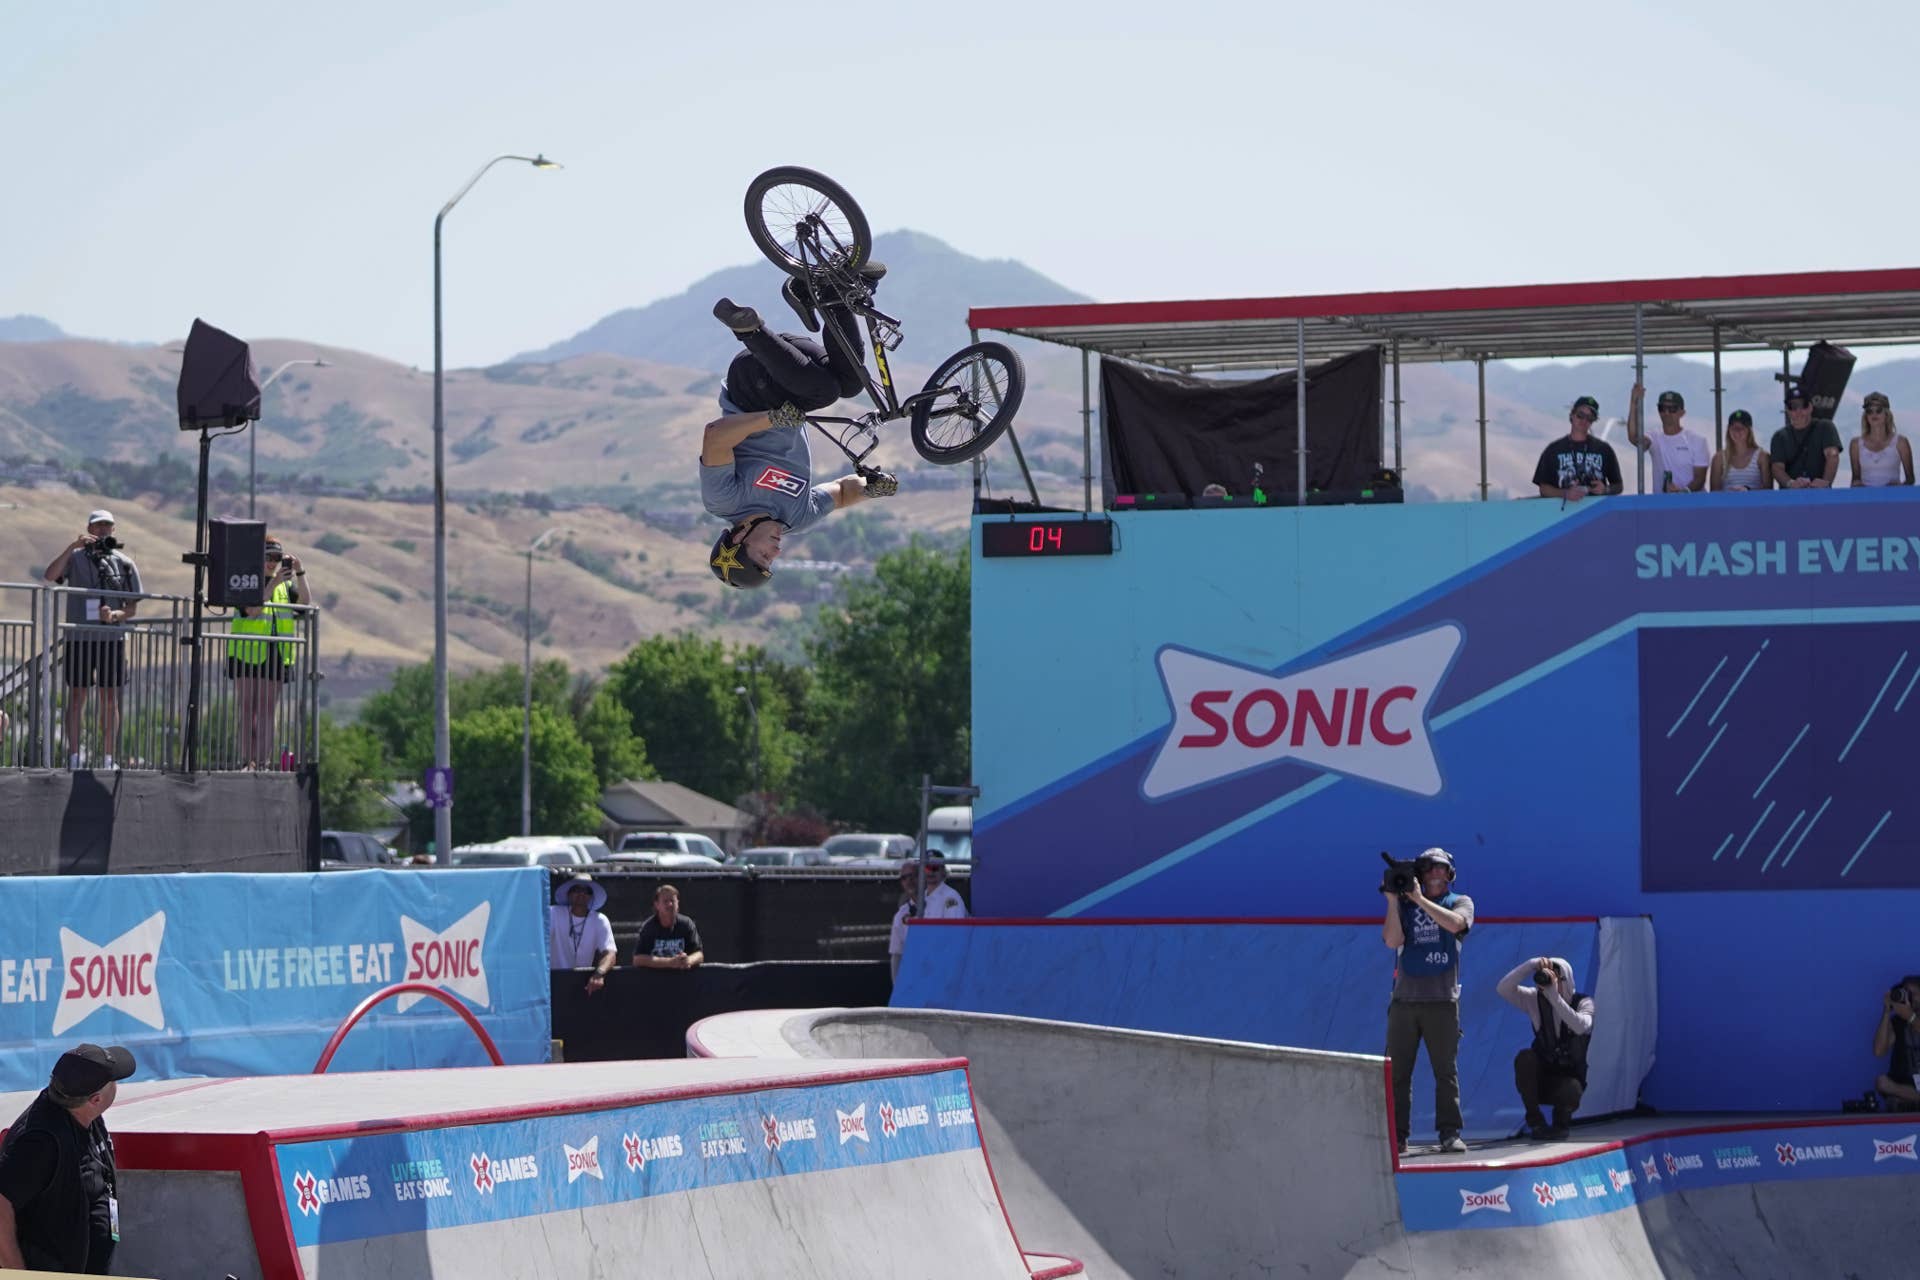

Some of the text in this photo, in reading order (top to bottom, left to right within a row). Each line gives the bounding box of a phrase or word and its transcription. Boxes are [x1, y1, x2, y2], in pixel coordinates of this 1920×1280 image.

[1029, 527, 1063, 551] 04
[1634, 540, 1787, 579] SMASH
[230, 574, 259, 590] OSA
[1178, 685, 1418, 749] SONIC
[223, 938, 480, 991] LIVE FREE EAT SONIC
[1425, 951, 1449, 965] 409
[1, 953, 153, 1003] EAT SONIC
[841, 1117, 865, 1133] SONIC
[894, 1104, 929, 1129] GAMES
[937, 1107, 975, 1128] EAT SONIC
[698, 1122, 718, 1140] LIVE
[779, 1118, 817, 1142] GAMES
[641, 1134, 683, 1161] GAMES
[701, 1136, 747, 1159] EAT SONIC
[1795, 1144, 1844, 1161] GAMES
[1877, 1143, 1913, 1155] SONIC
[391, 1159, 444, 1181] LIVE FREE
[491, 1155, 538, 1183] GAMES
[569, 1151, 598, 1170] SONIC
[1716, 1155, 1760, 1169] EAT SONIC
[317, 1174, 371, 1204] GAMES
[394, 1177, 452, 1201] EAT SONIC
[1465, 1193, 1505, 1206] SONIC
